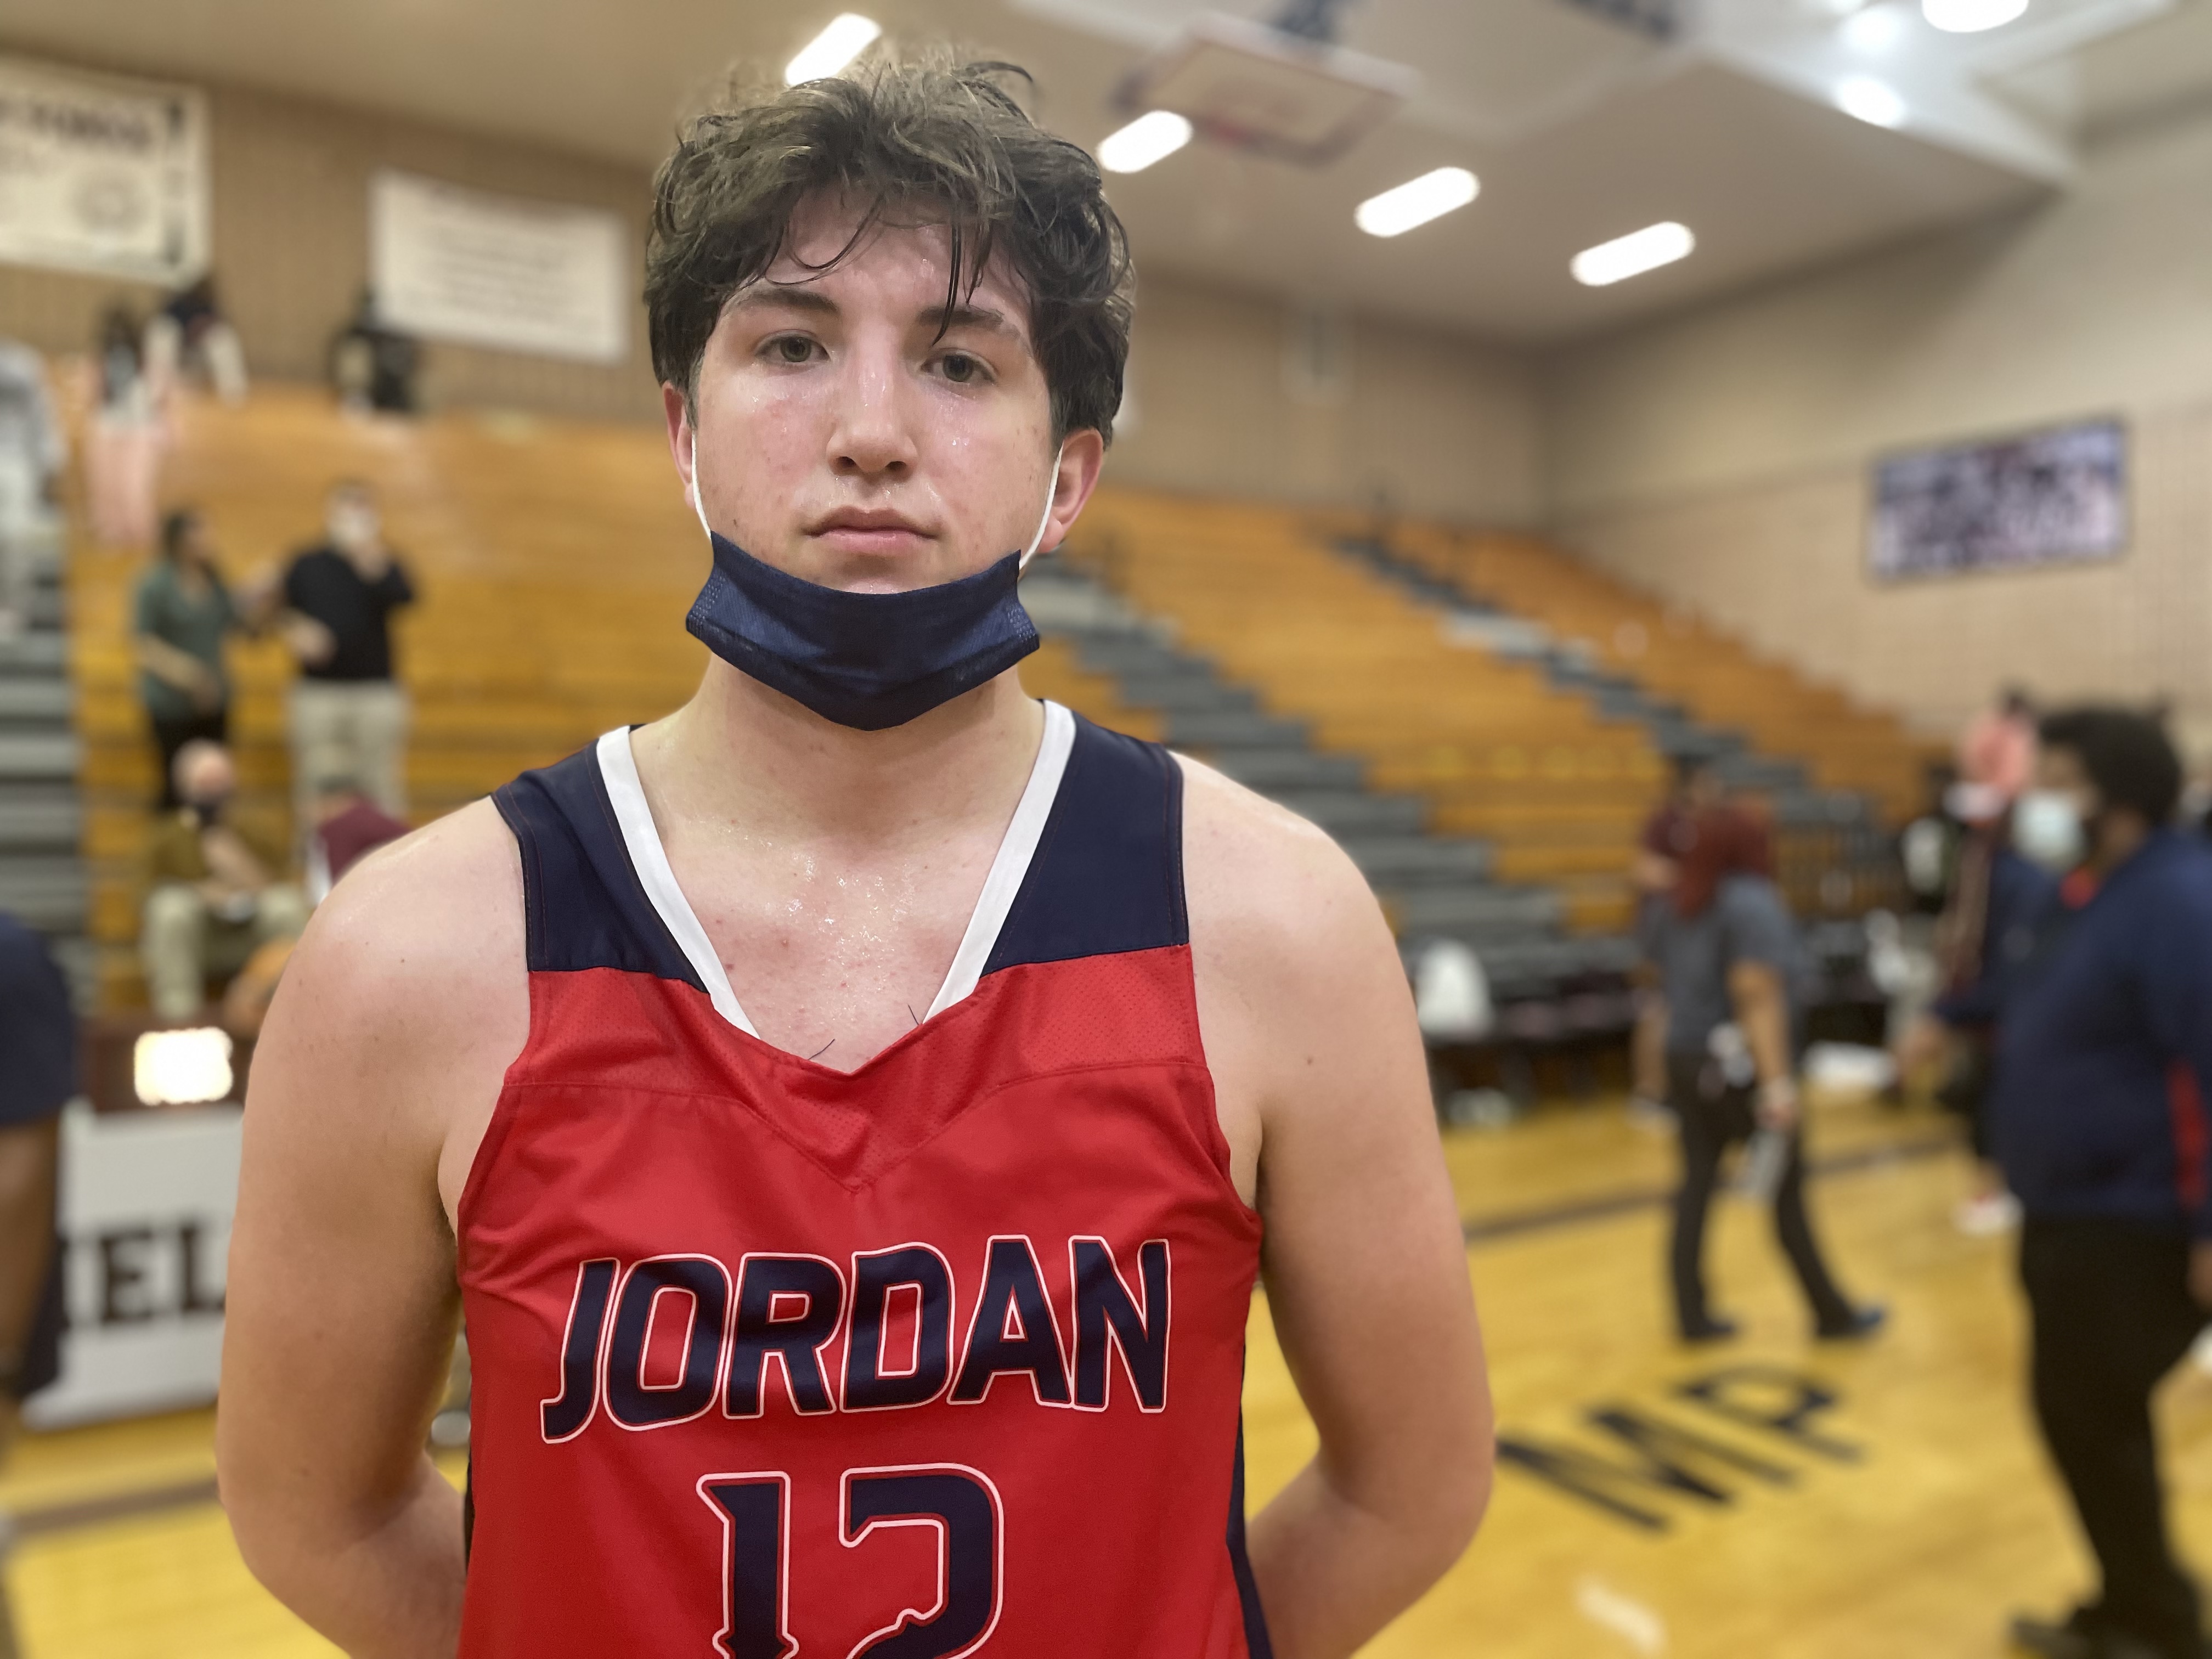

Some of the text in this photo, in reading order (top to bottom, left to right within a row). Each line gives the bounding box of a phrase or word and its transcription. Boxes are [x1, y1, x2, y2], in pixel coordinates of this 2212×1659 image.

[59, 1222, 227, 1324] EL
[540, 1234, 1172, 1443] JORDAN
[696, 1462, 1004, 1659] 12
